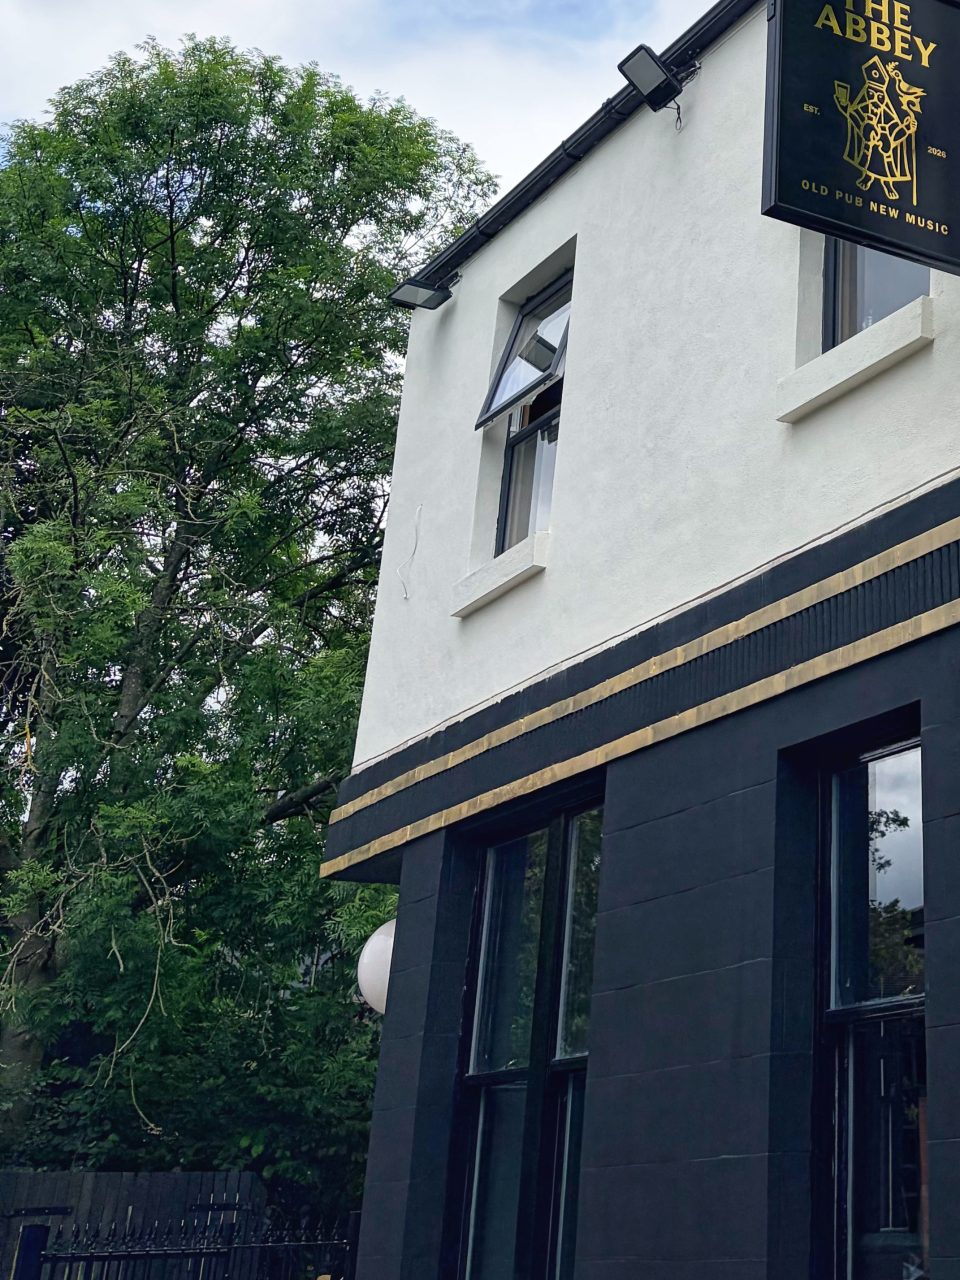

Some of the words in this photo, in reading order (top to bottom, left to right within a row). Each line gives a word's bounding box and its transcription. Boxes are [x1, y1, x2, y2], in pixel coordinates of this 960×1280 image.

[813, 3, 938, 68] ABBEY
[803, 103, 821, 116] EST.
[801, 179, 829, 196] OLD
[835, 189, 863, 207] PUB
[869, 200, 900, 219] NEW
[905, 212, 949, 235] MUSIC
